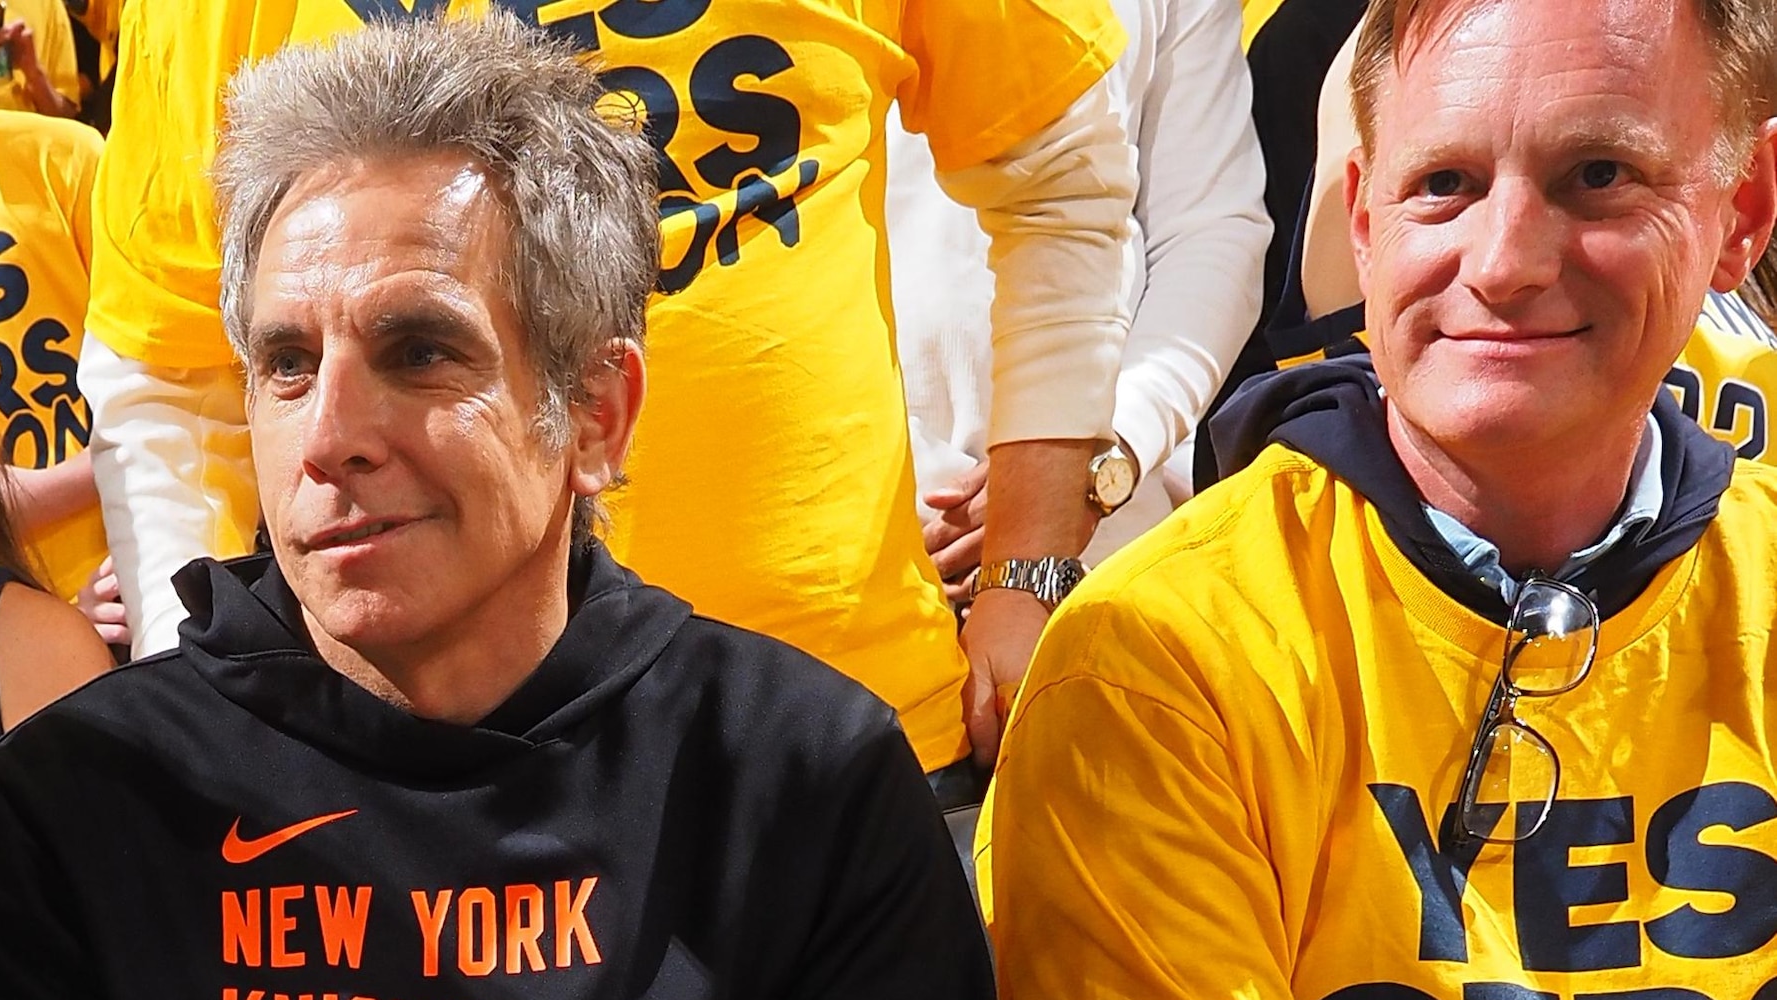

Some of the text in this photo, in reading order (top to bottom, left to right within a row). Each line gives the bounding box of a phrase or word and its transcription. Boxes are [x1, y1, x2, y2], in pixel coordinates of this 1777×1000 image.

[222, 876, 602, 977] NEW YORK
[1366, 780, 1777, 973] YES
